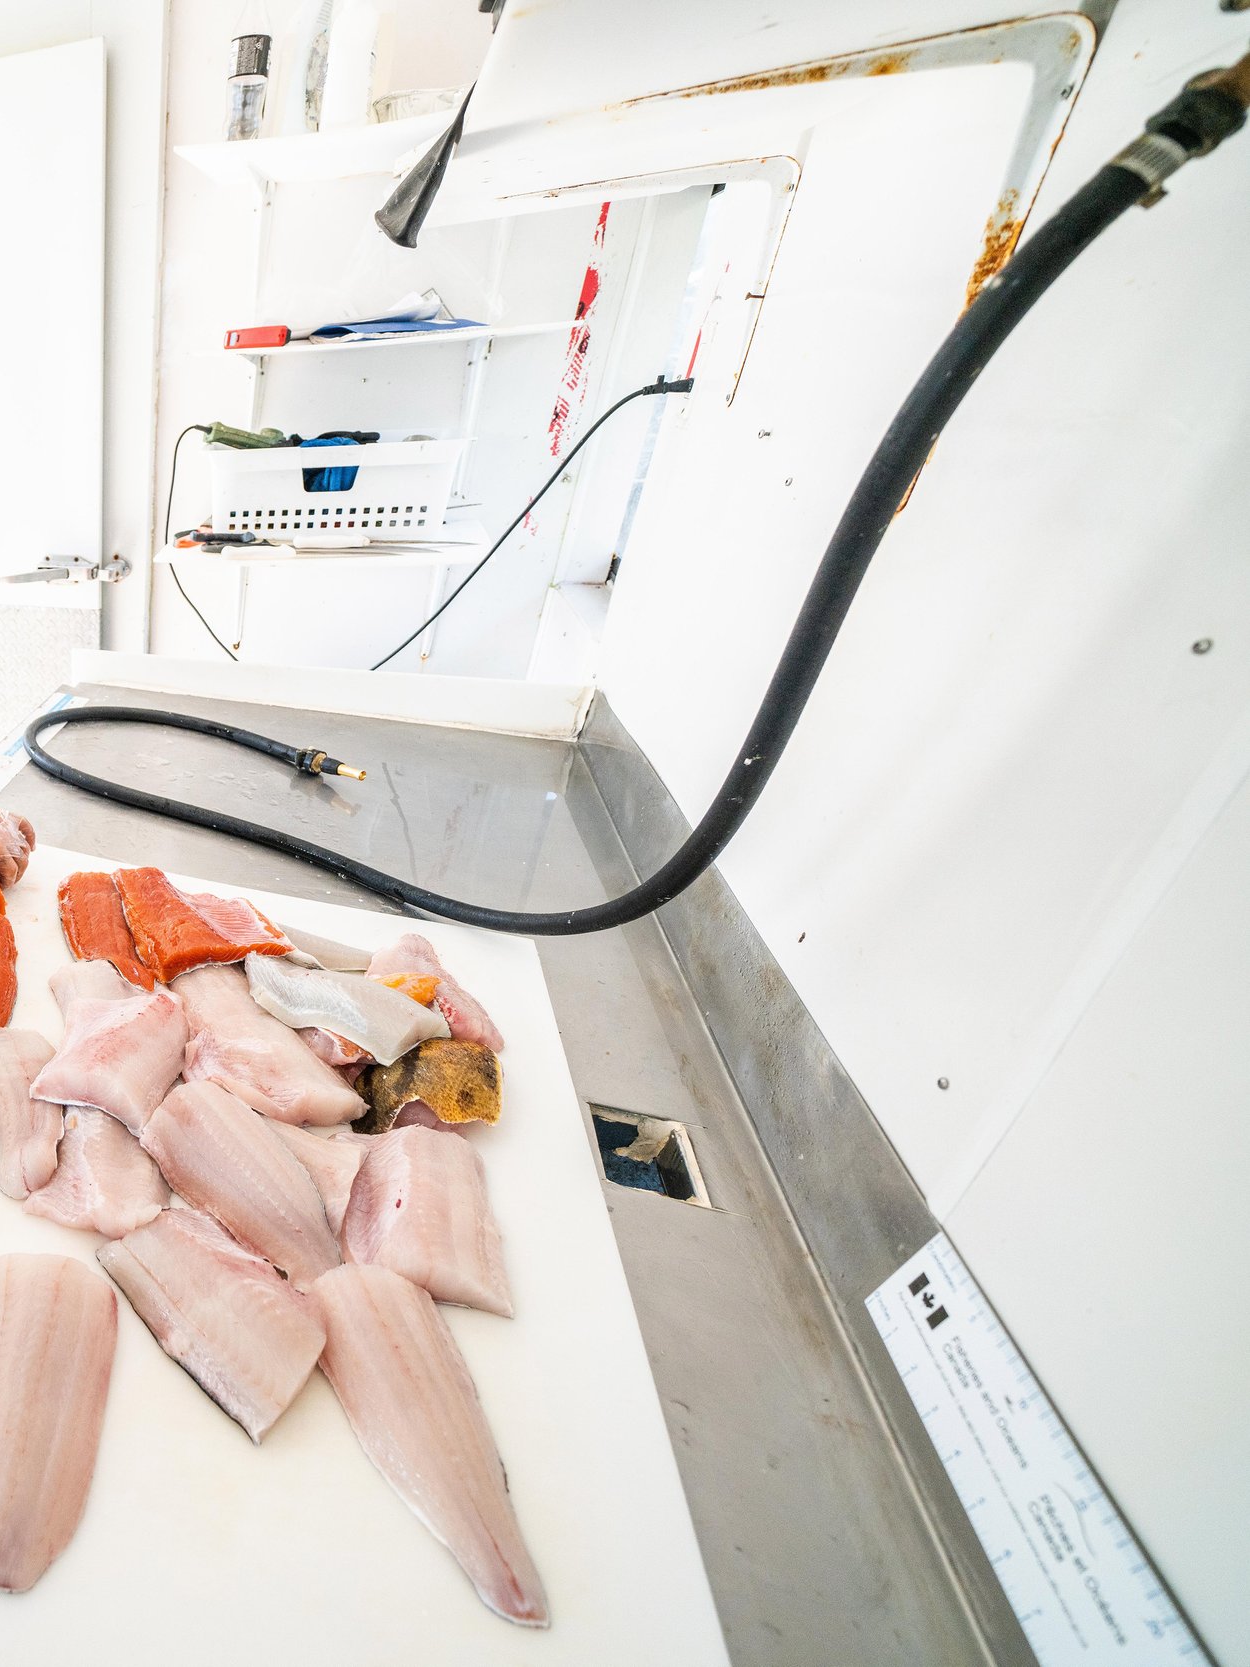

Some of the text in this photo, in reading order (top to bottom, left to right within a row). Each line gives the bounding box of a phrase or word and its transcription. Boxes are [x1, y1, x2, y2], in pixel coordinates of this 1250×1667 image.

[942, 1342, 970, 1388] Canada
[953, 1336, 983, 1388] Fisheries
[982, 1391, 999, 1414] and
[997, 1417, 1028, 1469] Oceans
[1028, 1501, 1064, 1562] Canada
